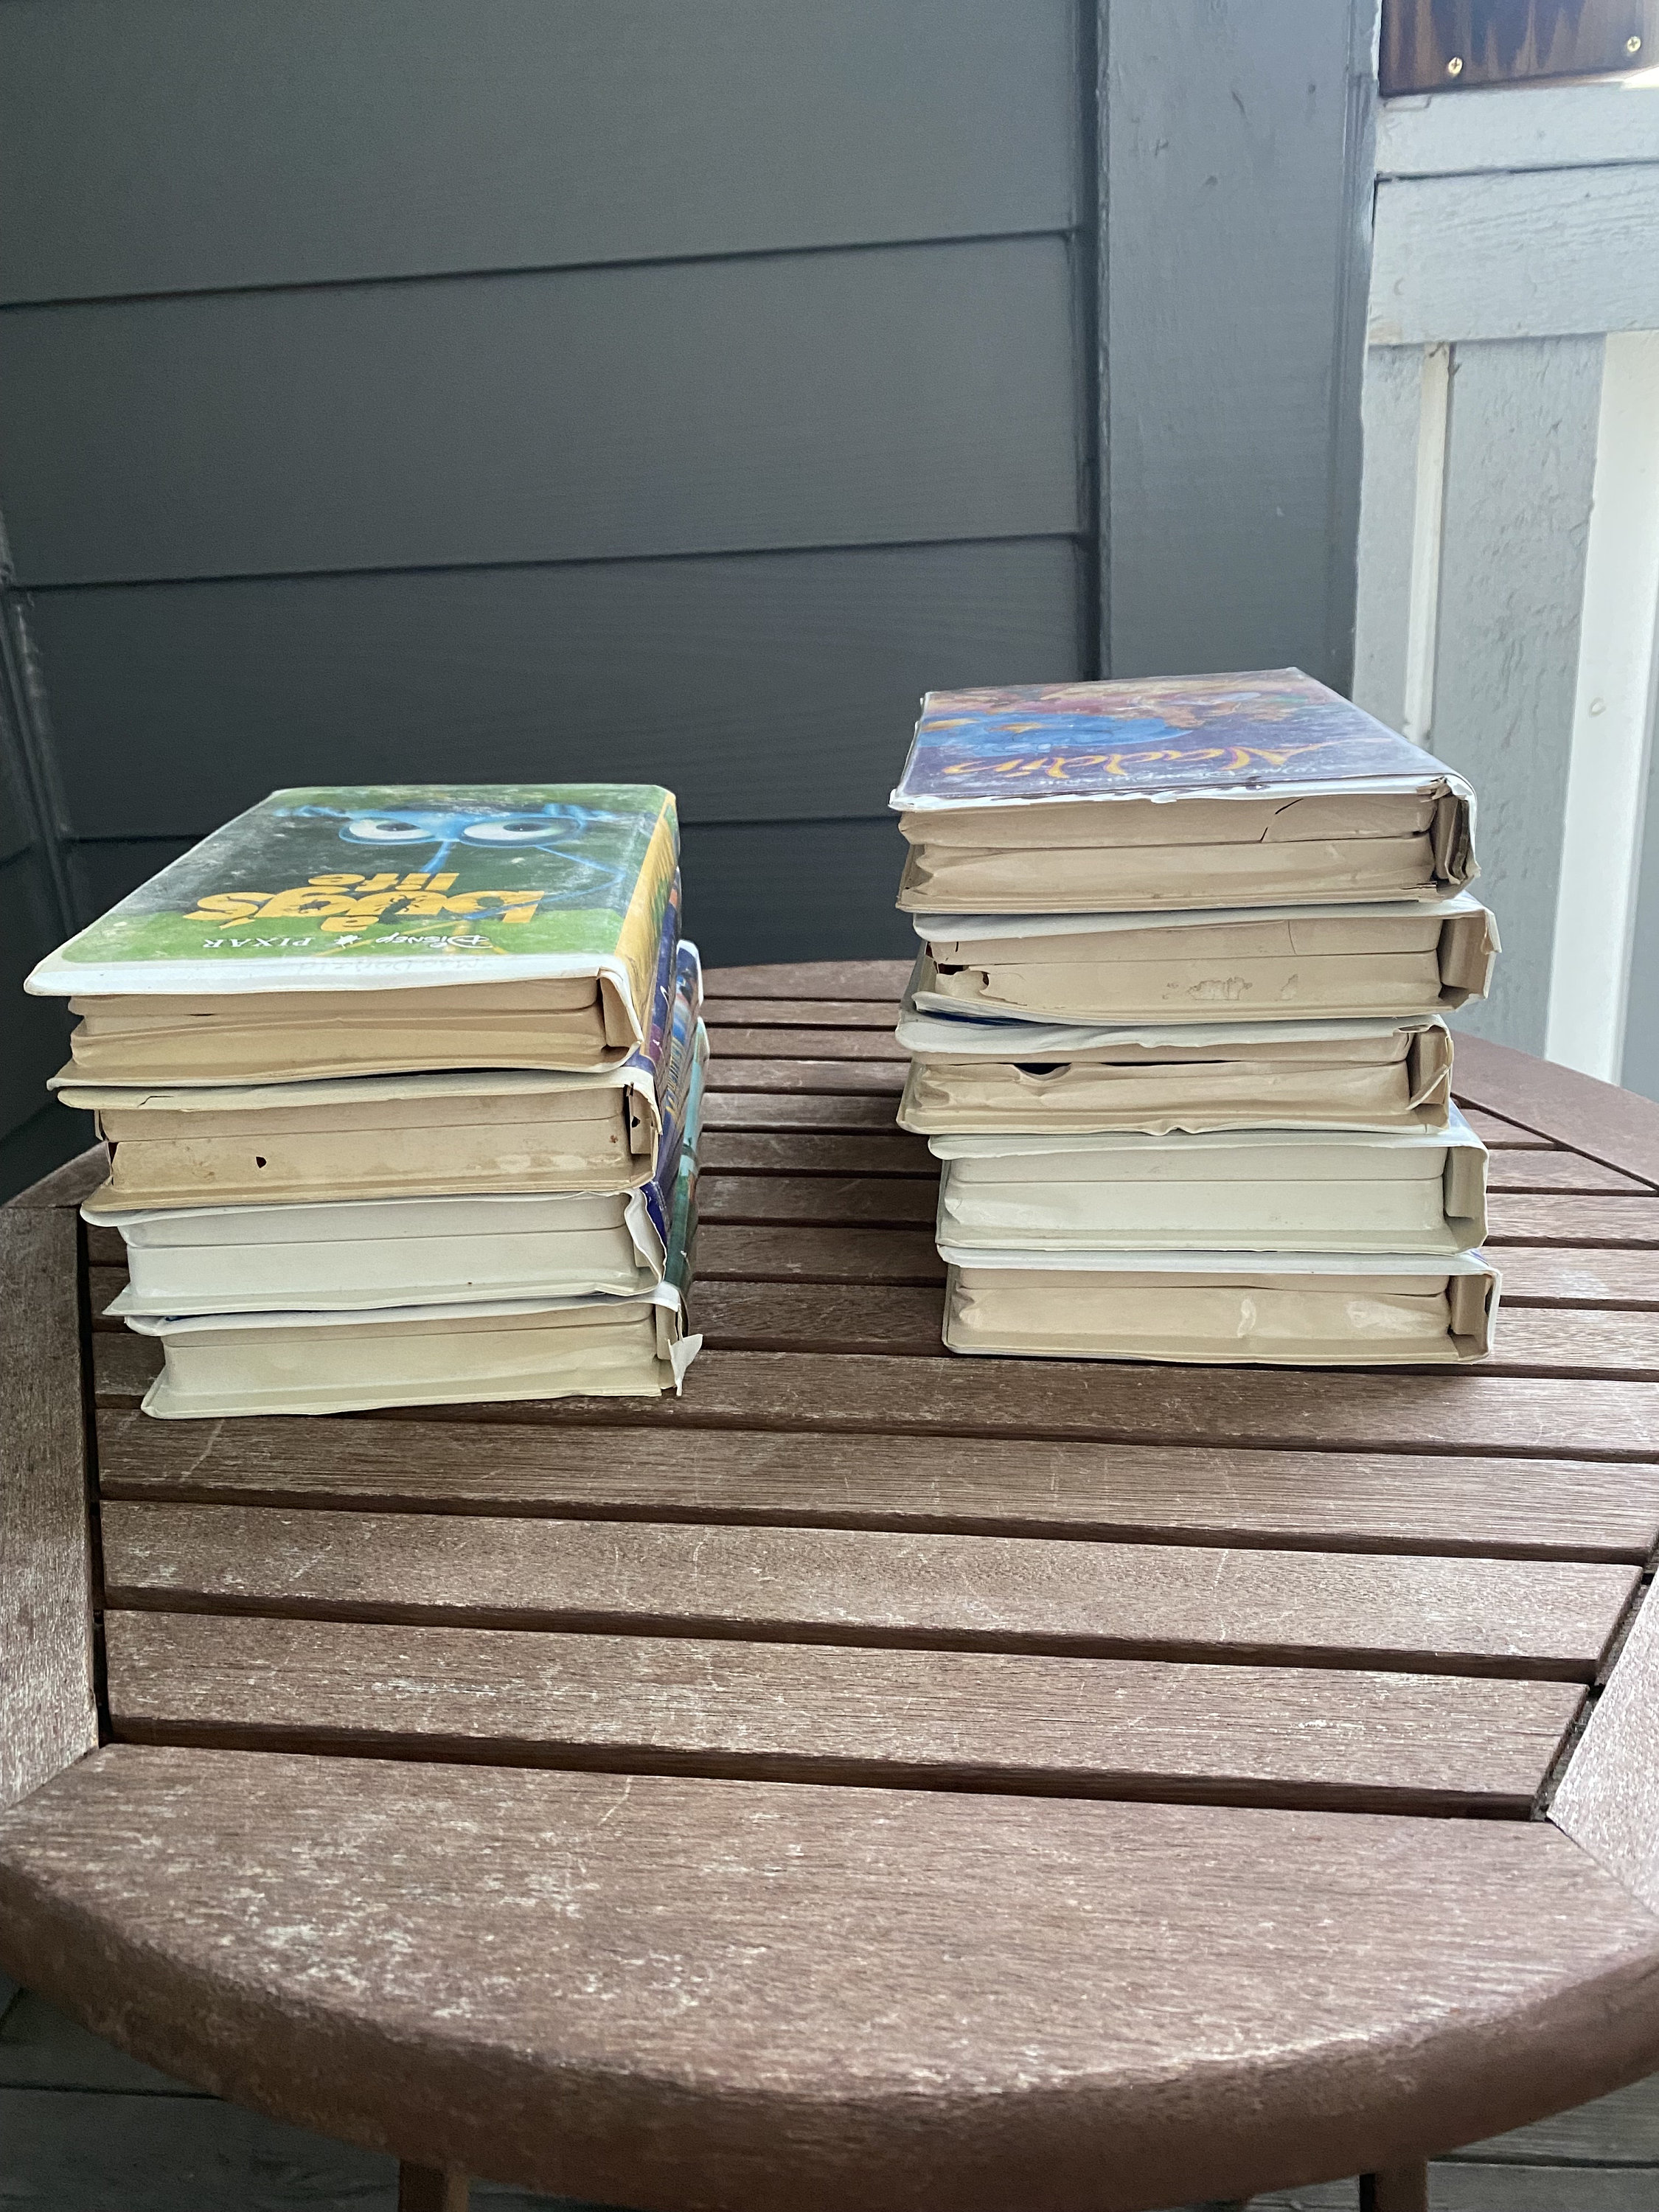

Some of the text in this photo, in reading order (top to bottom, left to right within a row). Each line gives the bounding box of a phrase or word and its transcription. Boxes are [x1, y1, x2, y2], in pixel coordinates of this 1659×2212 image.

[941, 740, 1343, 779] Aladdin
[307, 872, 460, 892] life
[182, 885, 545, 929] bug's
[320, 916, 379, 932] a
[202, 936, 316, 949] PIXAR
